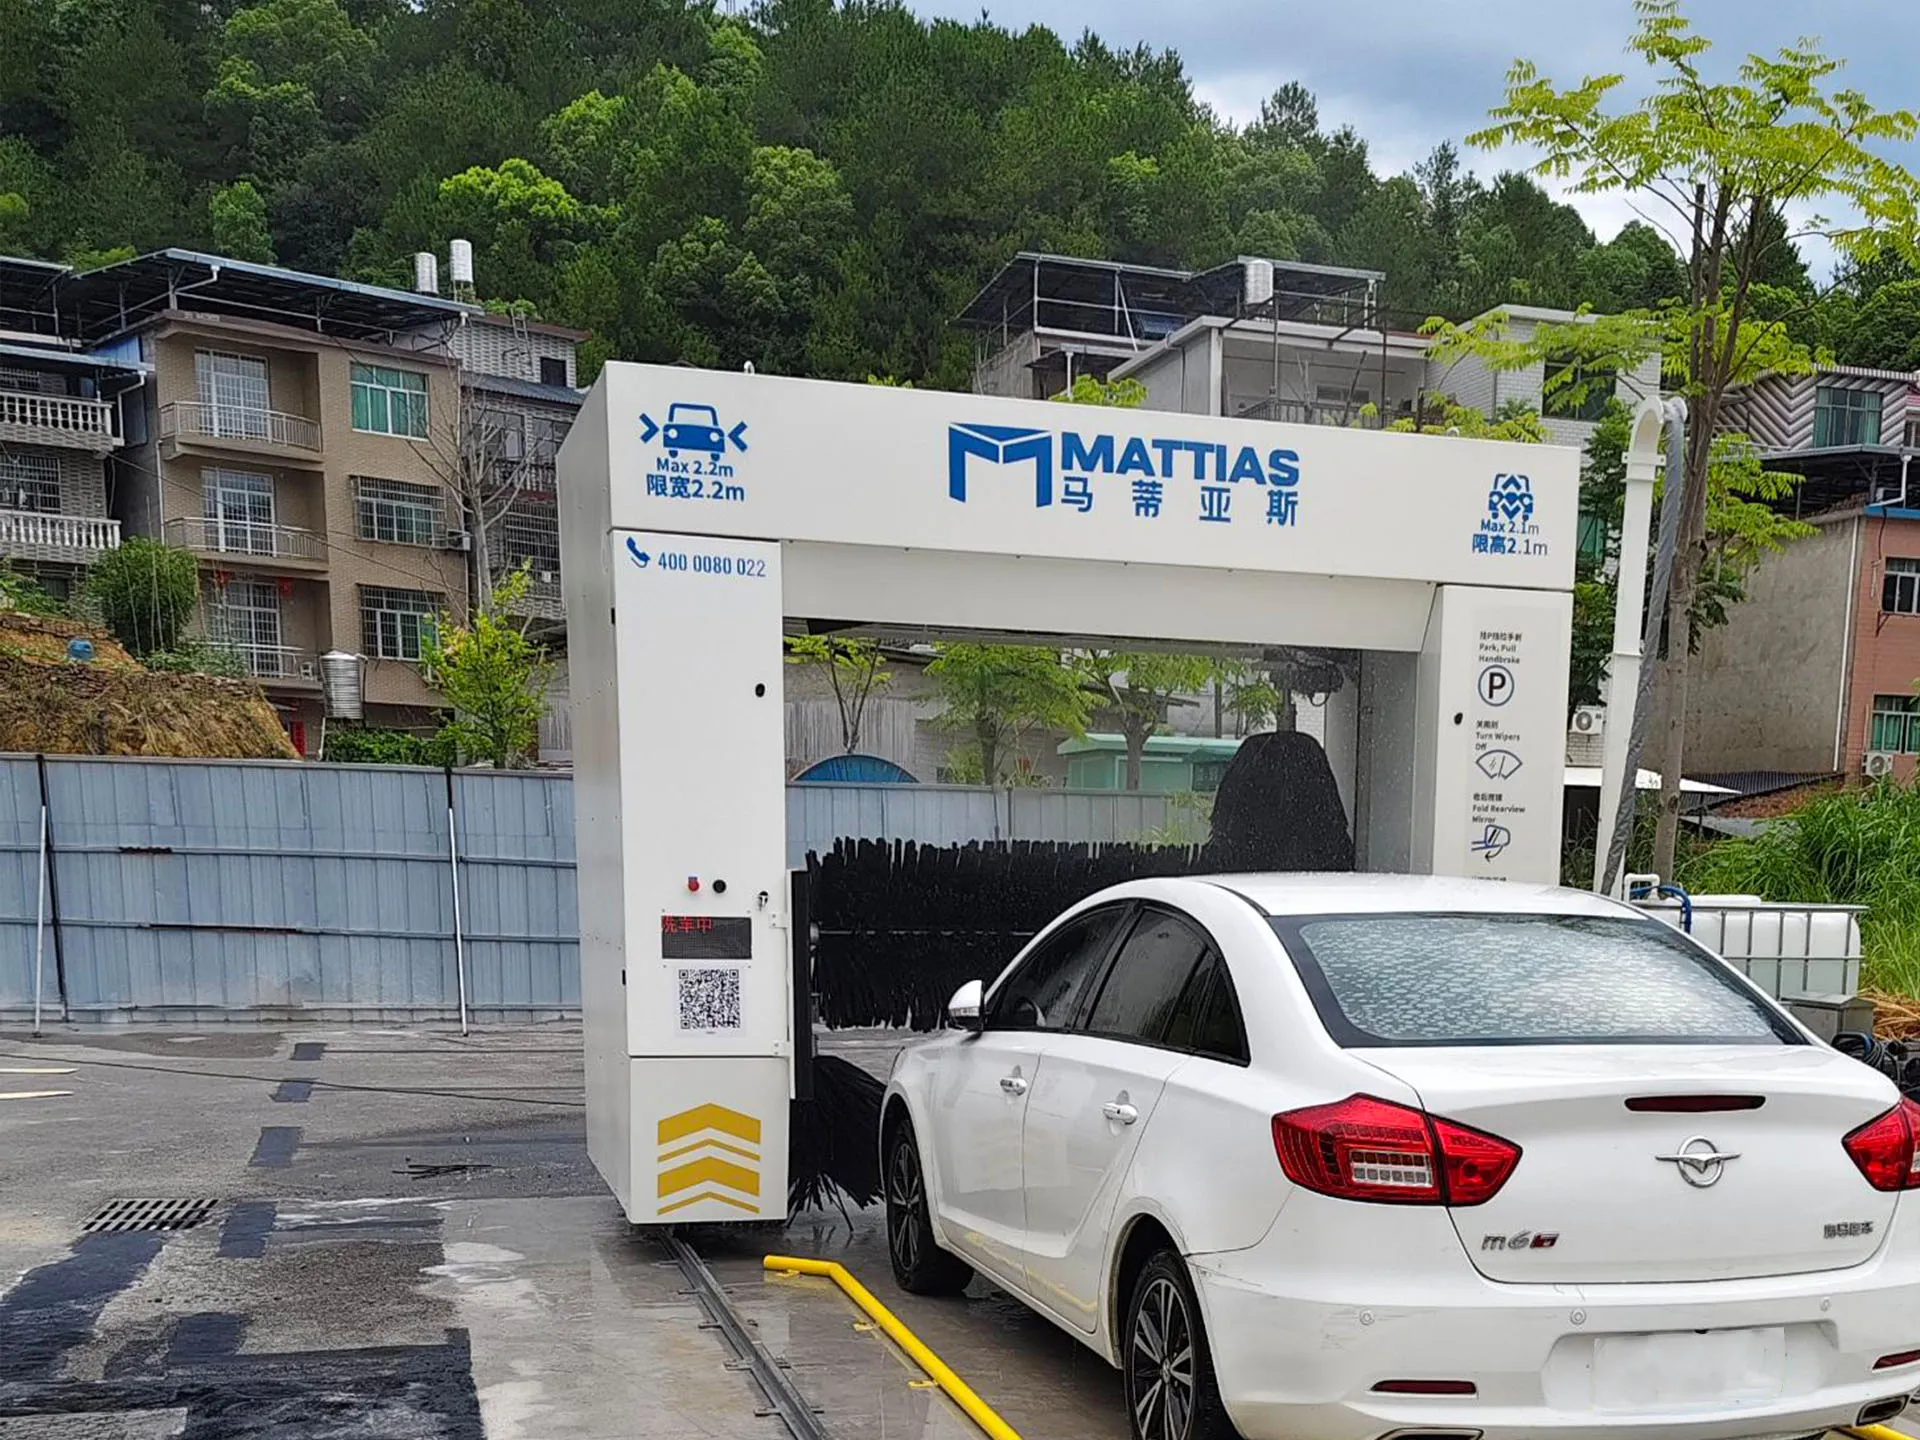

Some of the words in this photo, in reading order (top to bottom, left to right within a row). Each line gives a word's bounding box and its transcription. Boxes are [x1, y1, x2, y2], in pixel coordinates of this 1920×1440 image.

[656, 457, 689, 474] Max
[693, 460, 734, 477] 2.2m
[1061, 432, 1300, 487] MATTIAS
[646, 474, 745, 501] 限宽2.2m
[1061, 476, 1299, 526] 马蒂亚斯
[1480, 519, 1505, 532] Max
[1508, 521, 1540, 535] 2.1m
[1472, 533, 1548, 555] 限高2.1m
[658, 552, 687, 571] 400
[693, 555, 732, 574] 0080
[736, 557, 766, 577] 022
[1488, 672, 1506, 699] P
